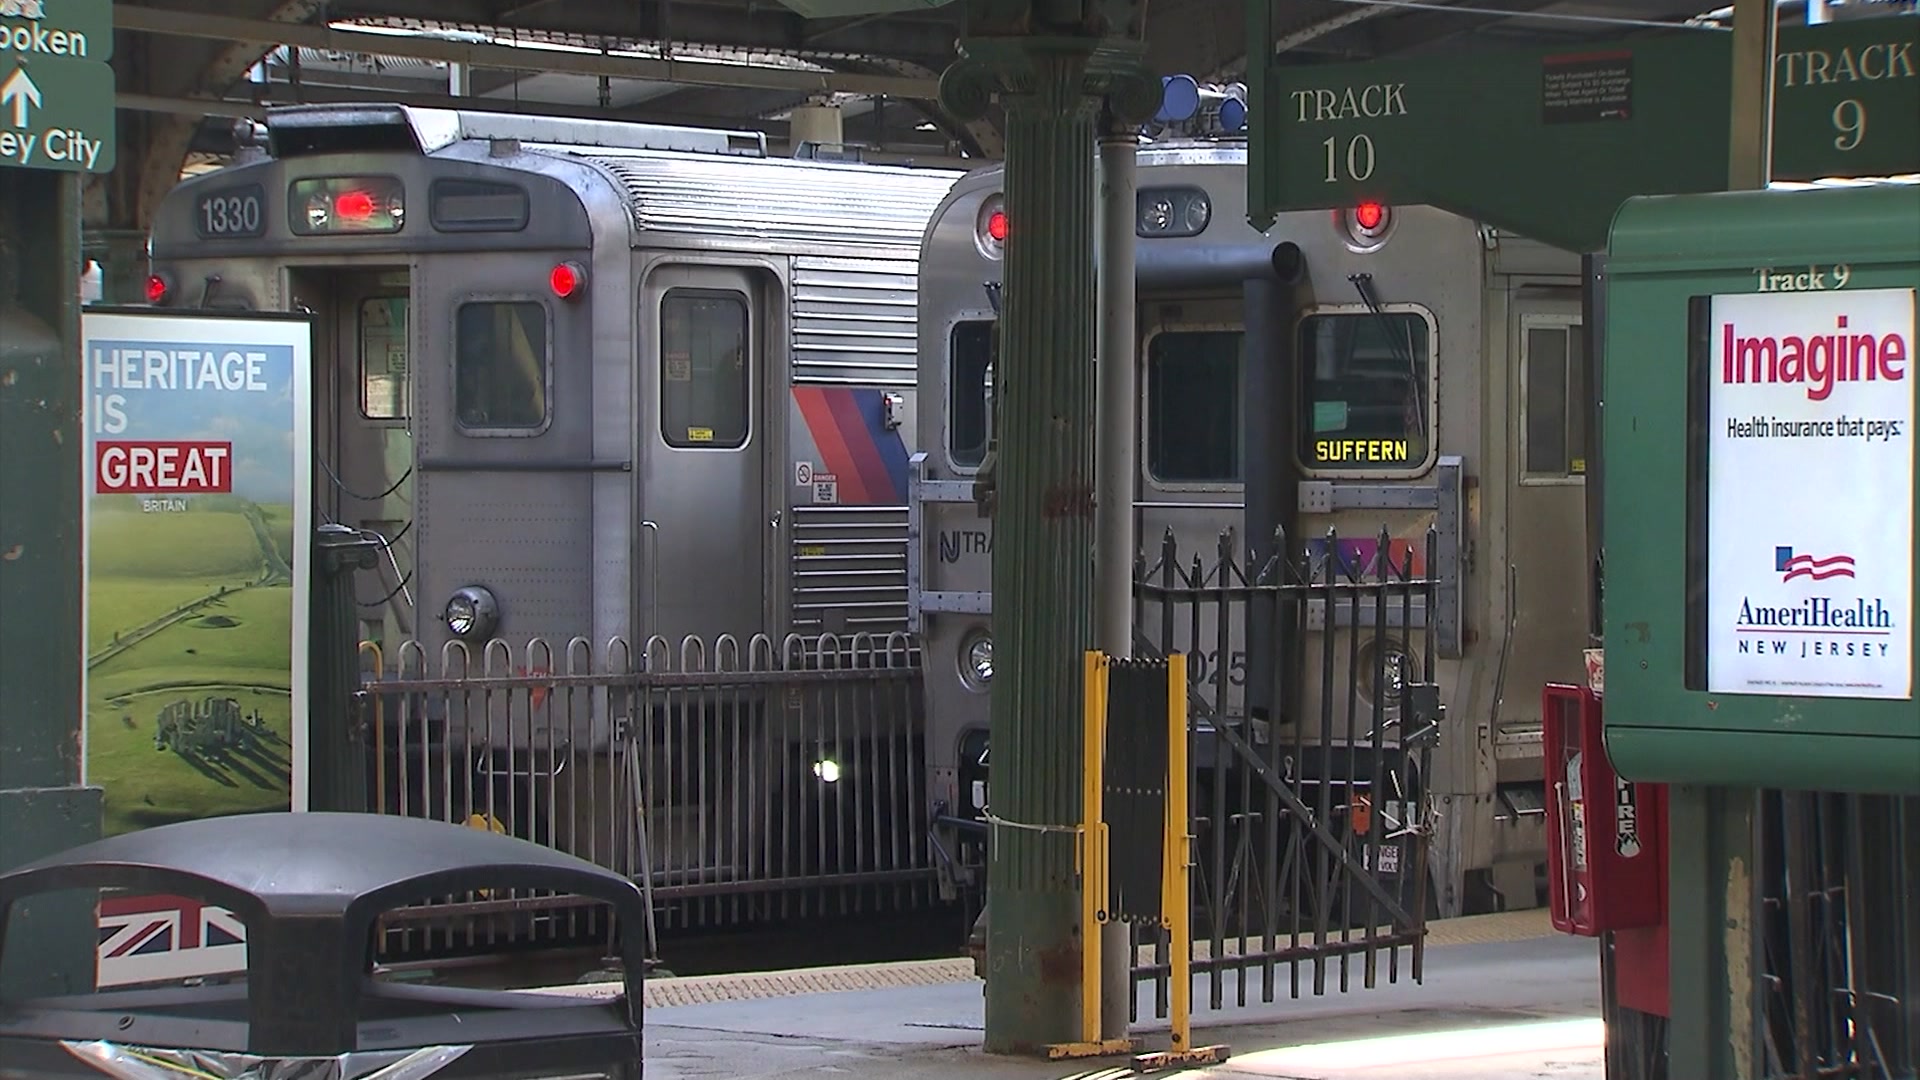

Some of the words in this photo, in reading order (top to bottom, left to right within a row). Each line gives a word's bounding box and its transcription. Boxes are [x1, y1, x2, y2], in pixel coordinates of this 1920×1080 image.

[1776, 42, 1916, 87] TRACK
[1290, 83, 1408, 122] TRACK
[1832, 99, 1867, 151] 9
[43, 128, 102, 170] City
[1323, 134, 1377, 183] 10
[203, 196, 260, 232] 1330
[1752, 264, 1825, 292] Track
[1833, 263, 1851, 290] 9
[94, 348, 268, 391] HERITAGE
[1722, 315, 1906, 401] Imagine
[95, 394, 128, 434] IS
[1727, 415, 1769, 438] Health
[1771, 416, 1834, 438] insurance
[1836, 415, 1863, 438] that
[100, 446, 228, 488] GREAT
[1315, 440, 1407, 461] SUFFERN
[143, 499, 187, 513] BRITAIN
[1736, 596, 1891, 628] AmeriHealth
[1738, 640, 1787, 655] NEW
[1801, 641, 1888, 658] JERSEY
